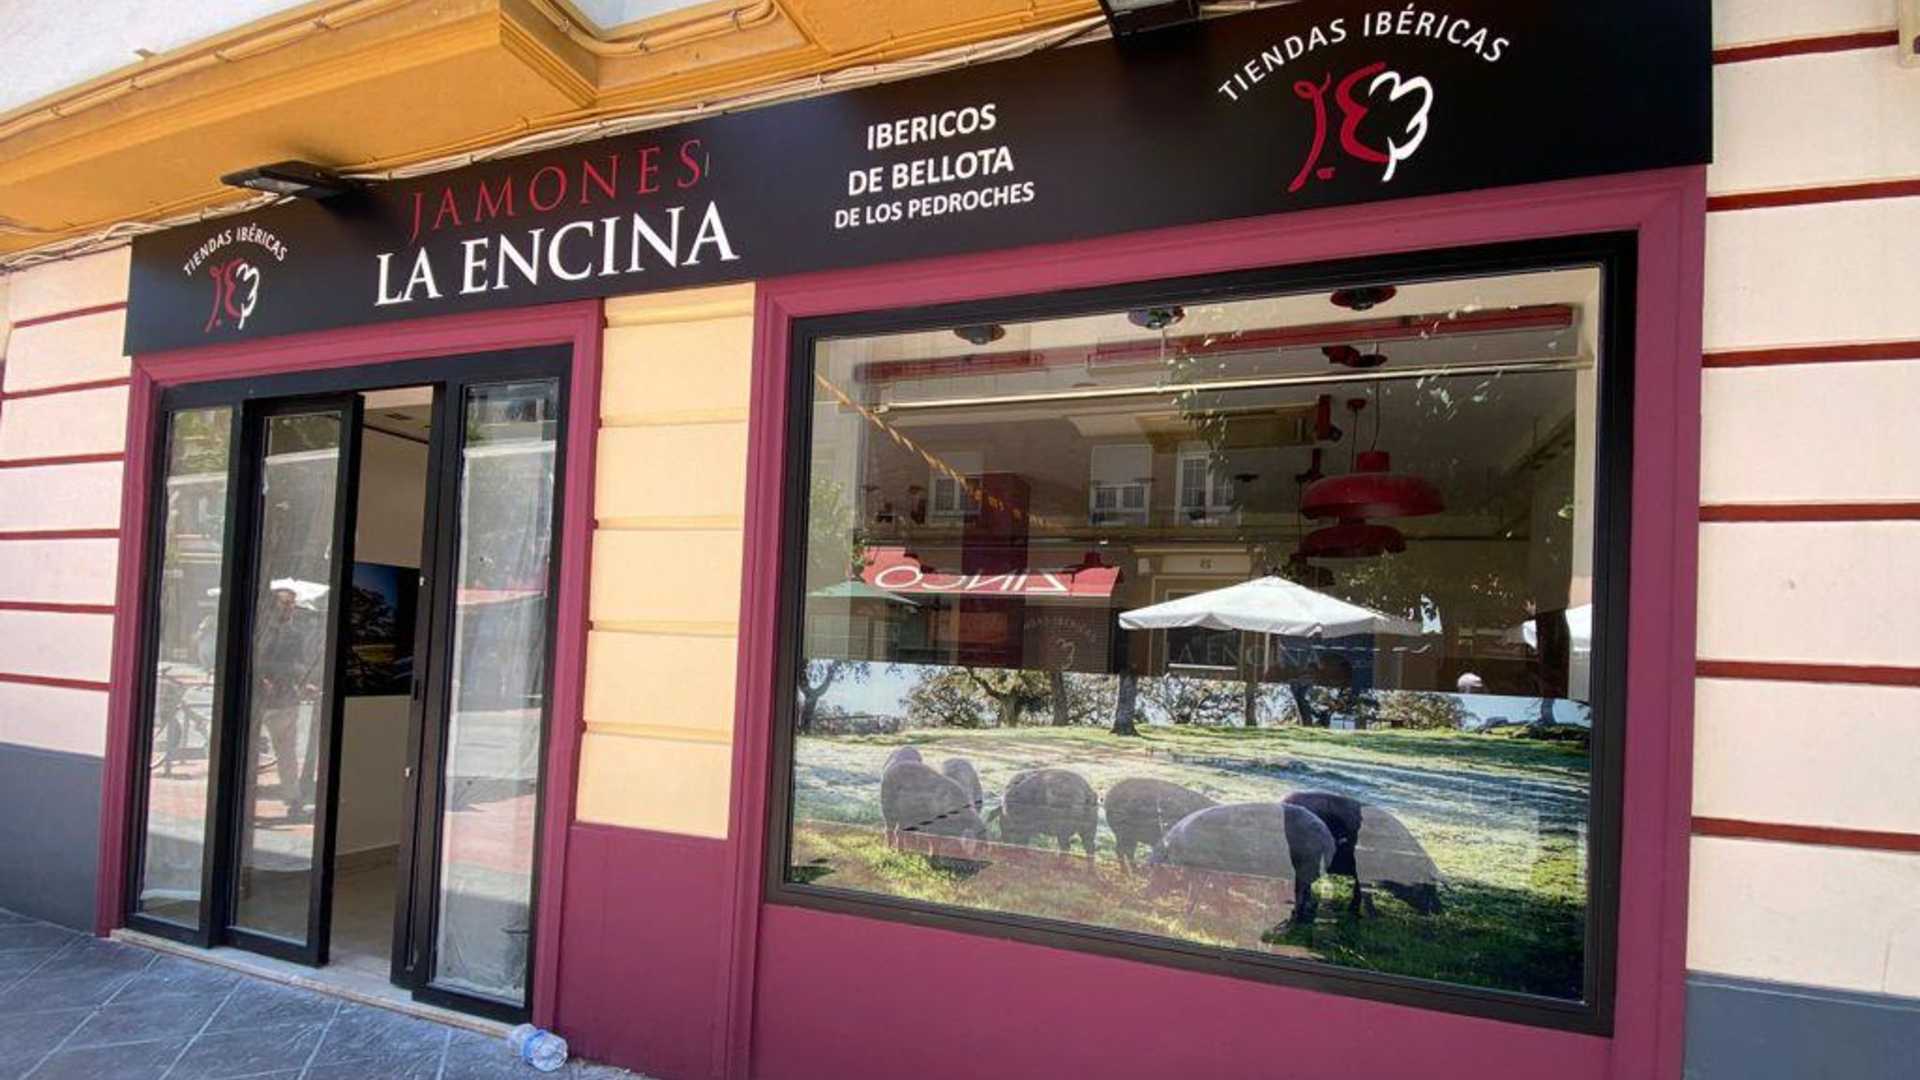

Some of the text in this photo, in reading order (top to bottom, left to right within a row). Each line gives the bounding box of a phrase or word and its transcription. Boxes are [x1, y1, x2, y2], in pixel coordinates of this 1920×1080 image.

[1217, 2, 1510, 102] TIENDAS IBÉRICAS
[866, 103, 997, 151] IBERICOS
[409, 139, 701, 243] JAMONES
[848, 145, 1015, 196] DE BELLOTA
[834, 181, 1035, 229] DE LOS PEDROCHES
[183, 222, 288, 277] TIENDAS IBÉRICAS
[374, 200, 741, 307] LA ENCINA
